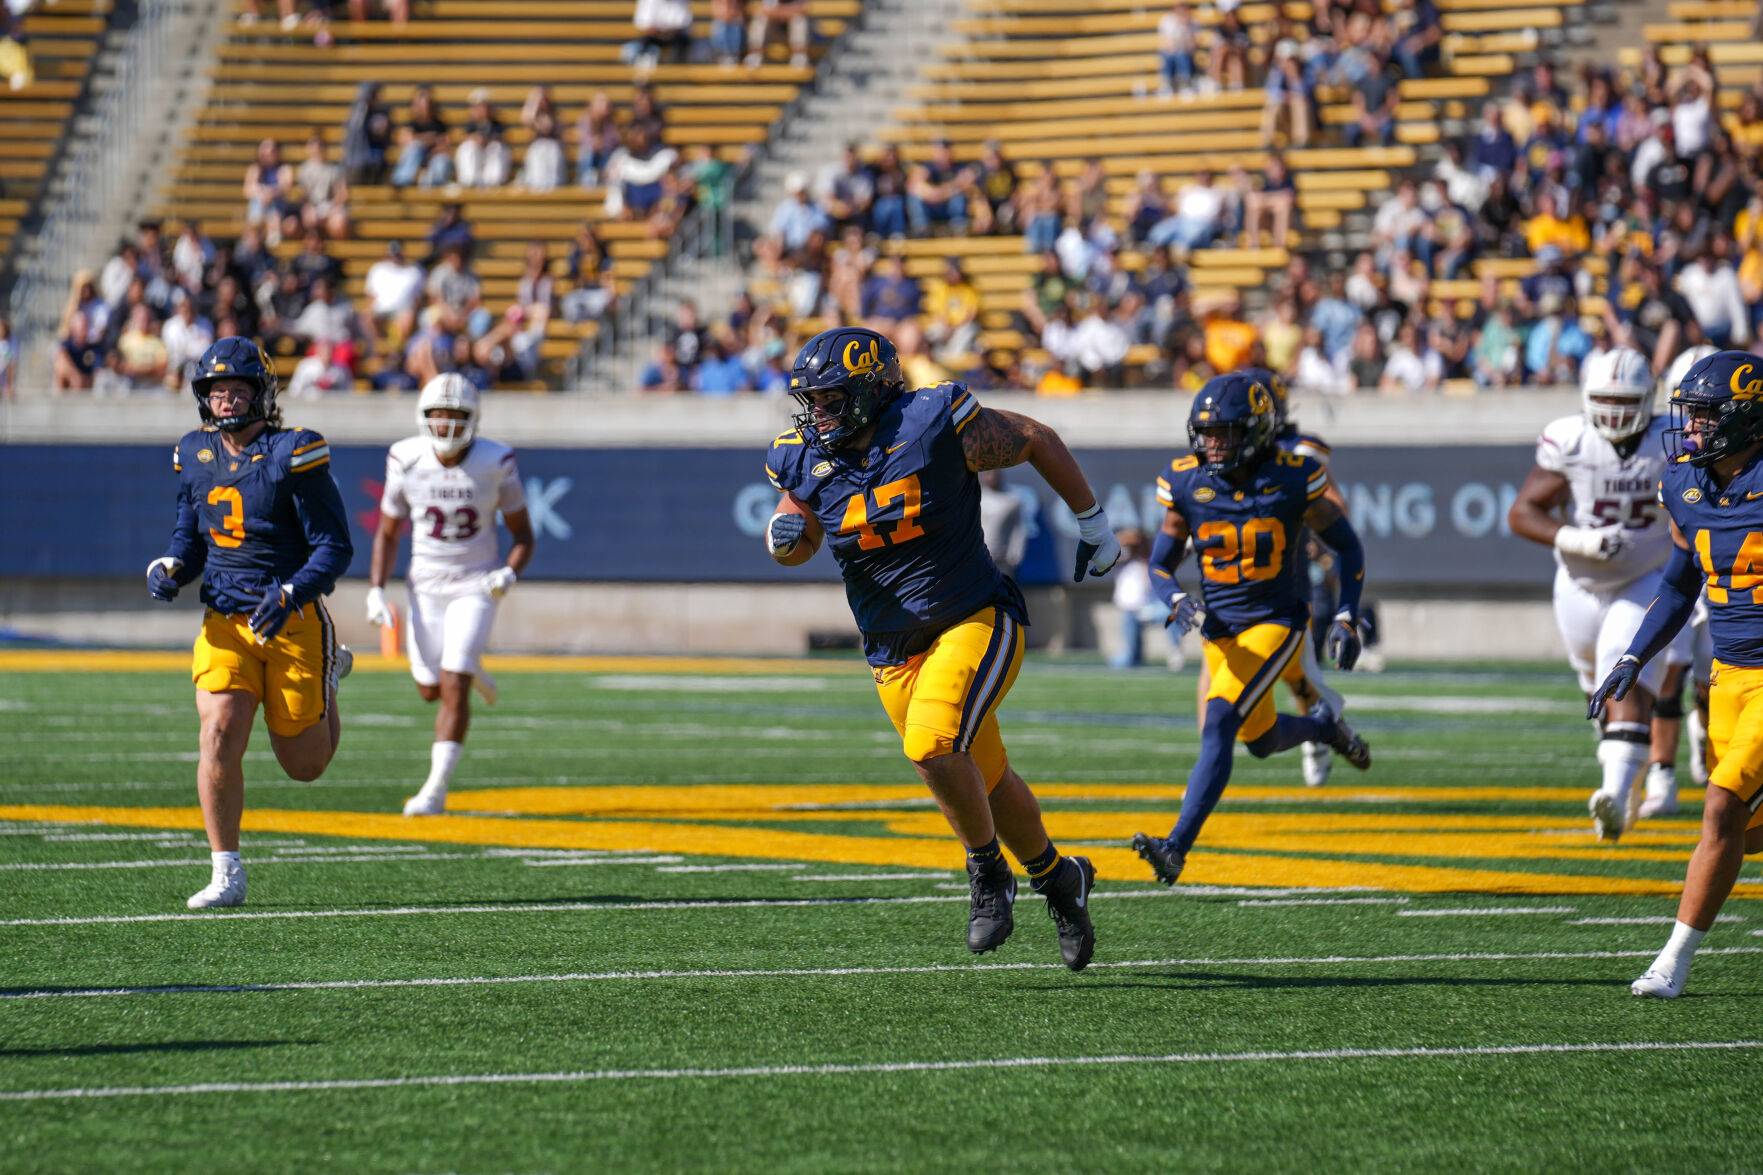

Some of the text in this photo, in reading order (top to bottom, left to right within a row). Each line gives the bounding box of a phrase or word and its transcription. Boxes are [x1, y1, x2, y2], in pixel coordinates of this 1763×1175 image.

[842, 340, 884, 378] Cal
[1729, 363, 1763, 402] Ca
[207, 486, 246, 548] 3
[425, 506, 481, 540] 23
[836, 473, 926, 551] 47
[1590, 499, 1657, 529] 55
[1197, 517, 1286, 584] 20
